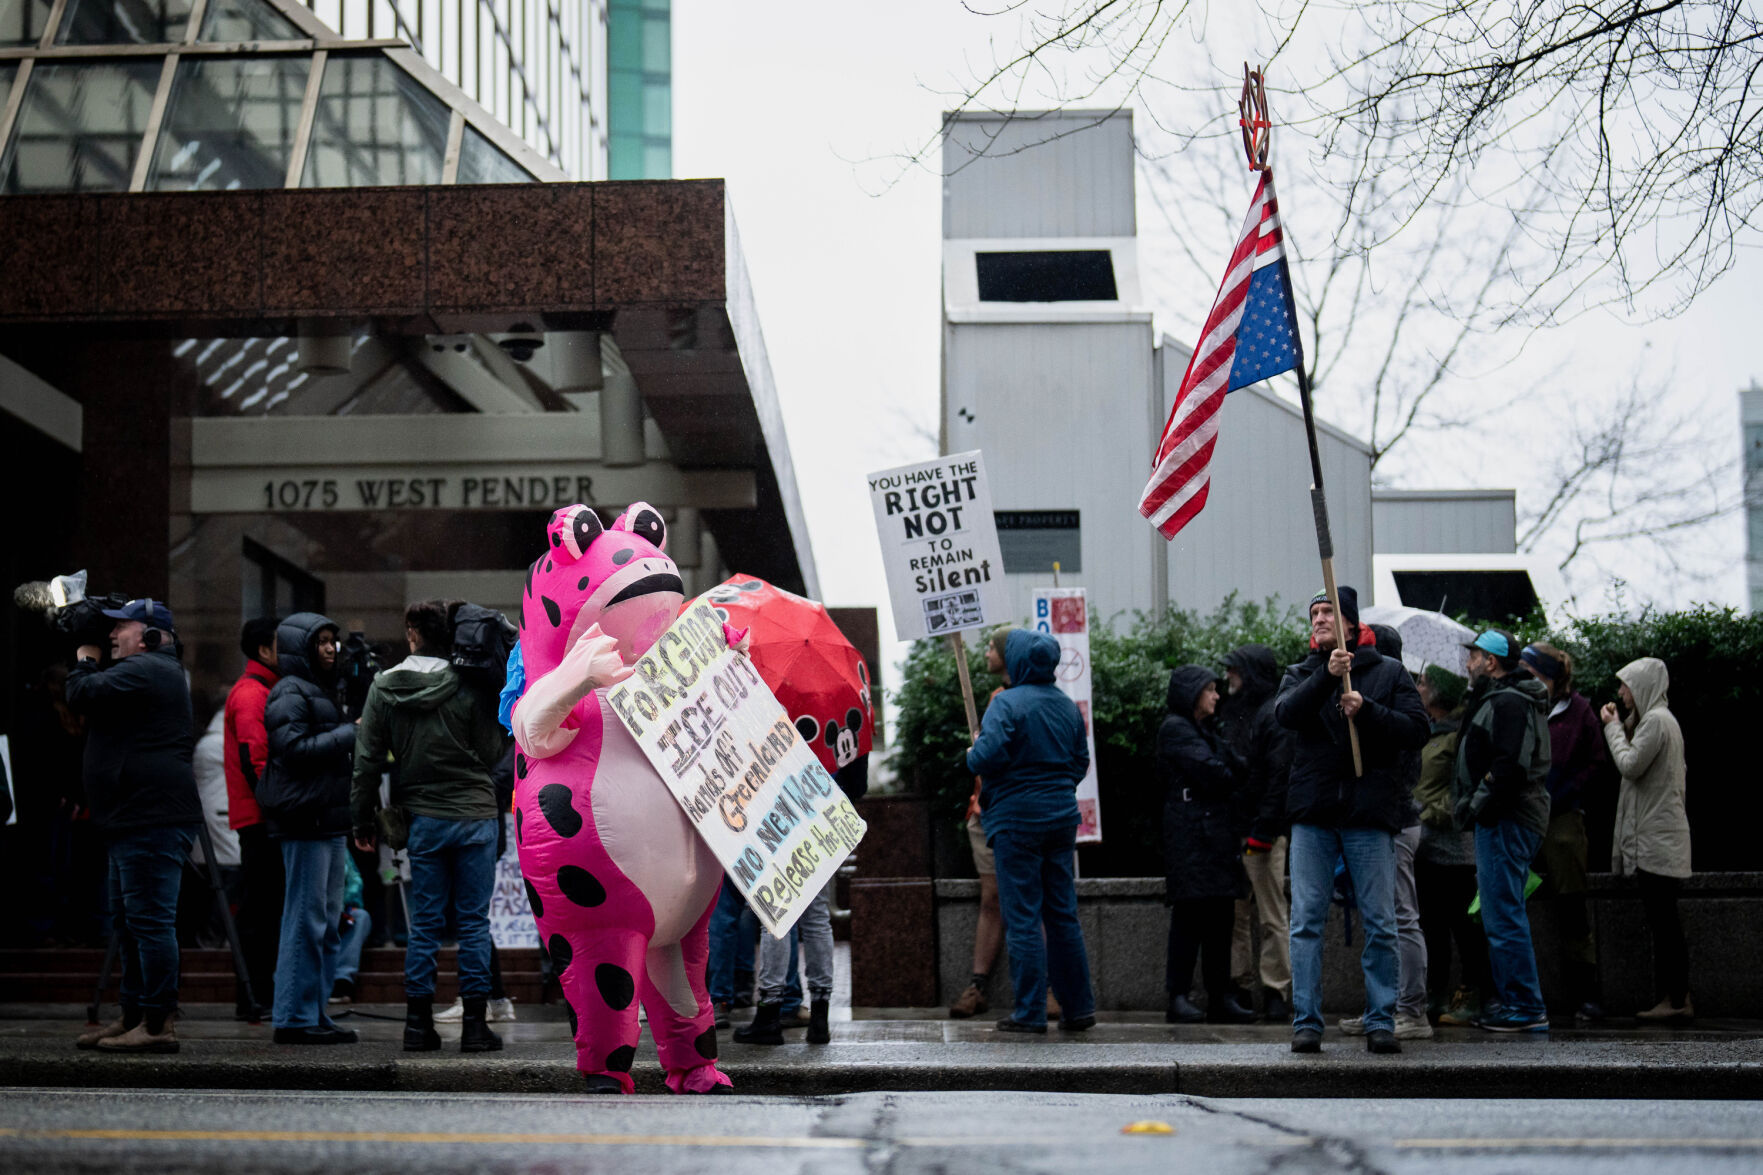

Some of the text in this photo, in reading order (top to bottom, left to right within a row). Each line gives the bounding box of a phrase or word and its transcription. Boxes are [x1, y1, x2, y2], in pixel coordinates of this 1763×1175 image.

[264, 475, 597, 508] 1075 WEST PENDER
[869, 461, 978, 492] YOU HAVE THE
[885, 476, 977, 516] RIGHT
[903, 506, 963, 539] NOT
[910, 548, 974, 571] REMAIN
[928, 538, 953, 553] TO
[657, 652, 758, 778] ICE OUT
[810, 825, 839, 857] the
